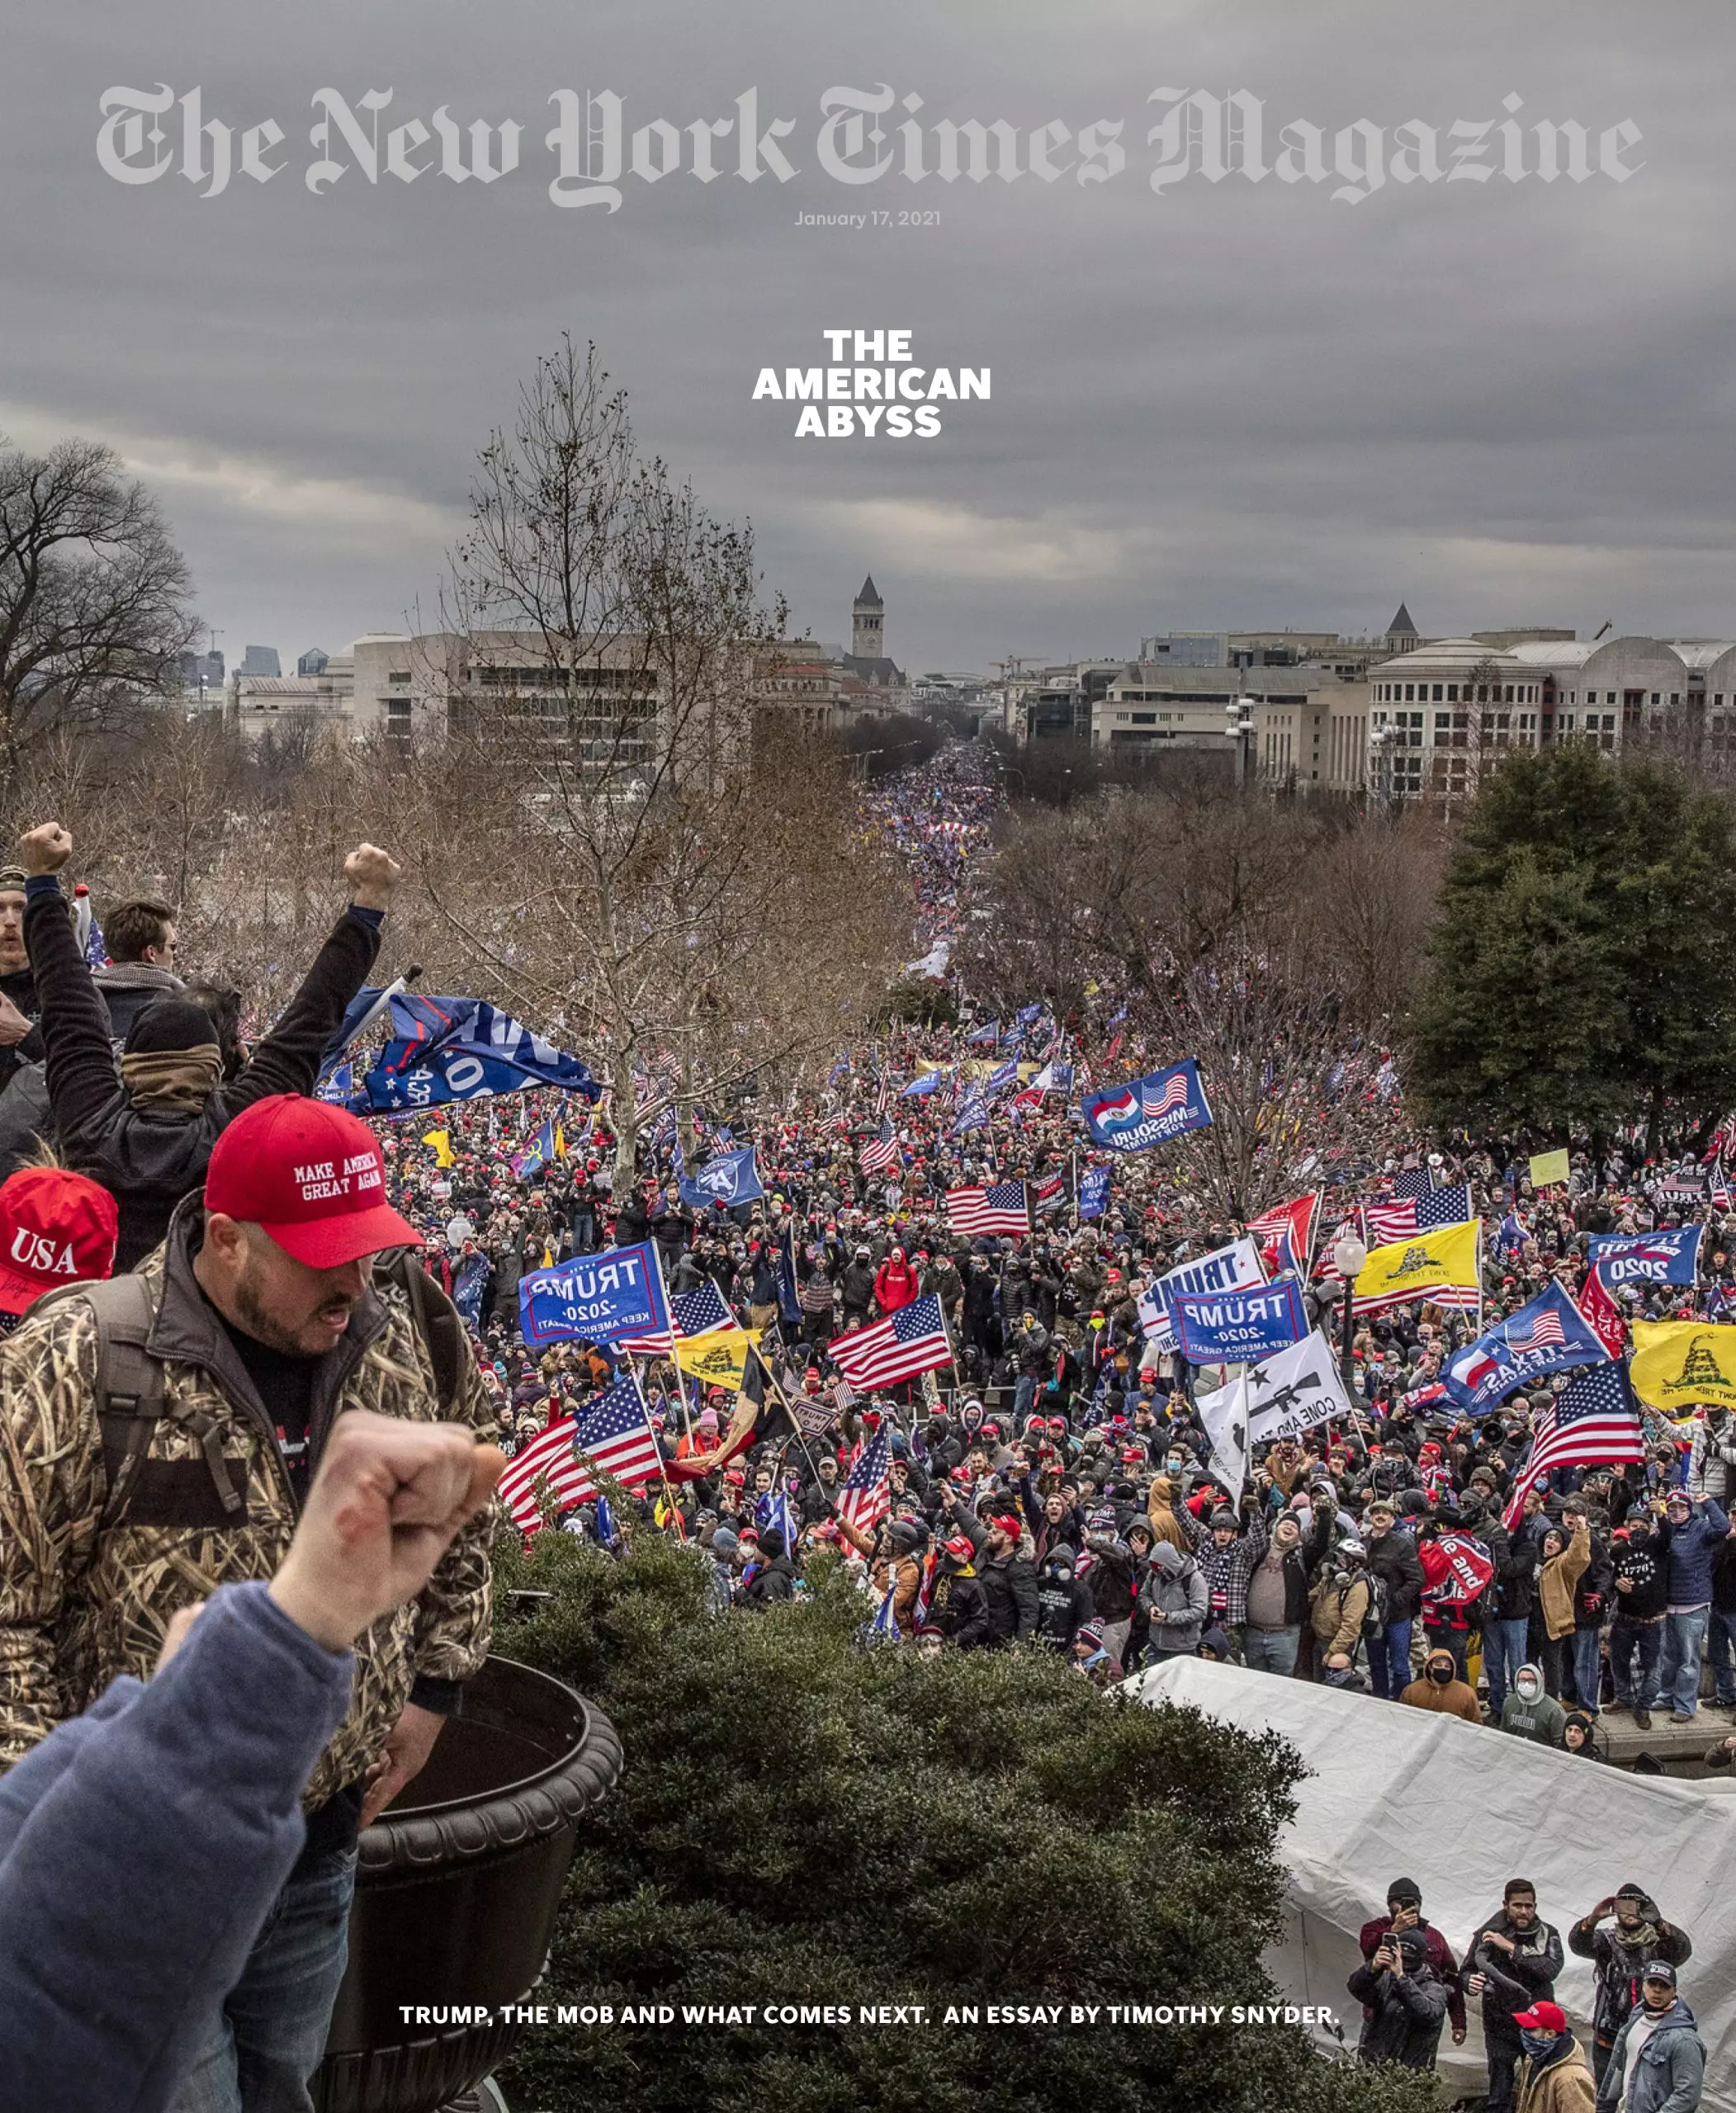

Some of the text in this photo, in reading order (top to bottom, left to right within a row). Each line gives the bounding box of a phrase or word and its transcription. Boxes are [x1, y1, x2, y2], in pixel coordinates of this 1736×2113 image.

[293, 1151, 378, 1184] MAKE AMERICA
[301, 1169, 381, 1201] GREAT AGAIN
[11, 1227, 79, 1275] USA
[799, 1408, 826, 1421] TRUMP
[1452, 1556, 1484, 1589] and
